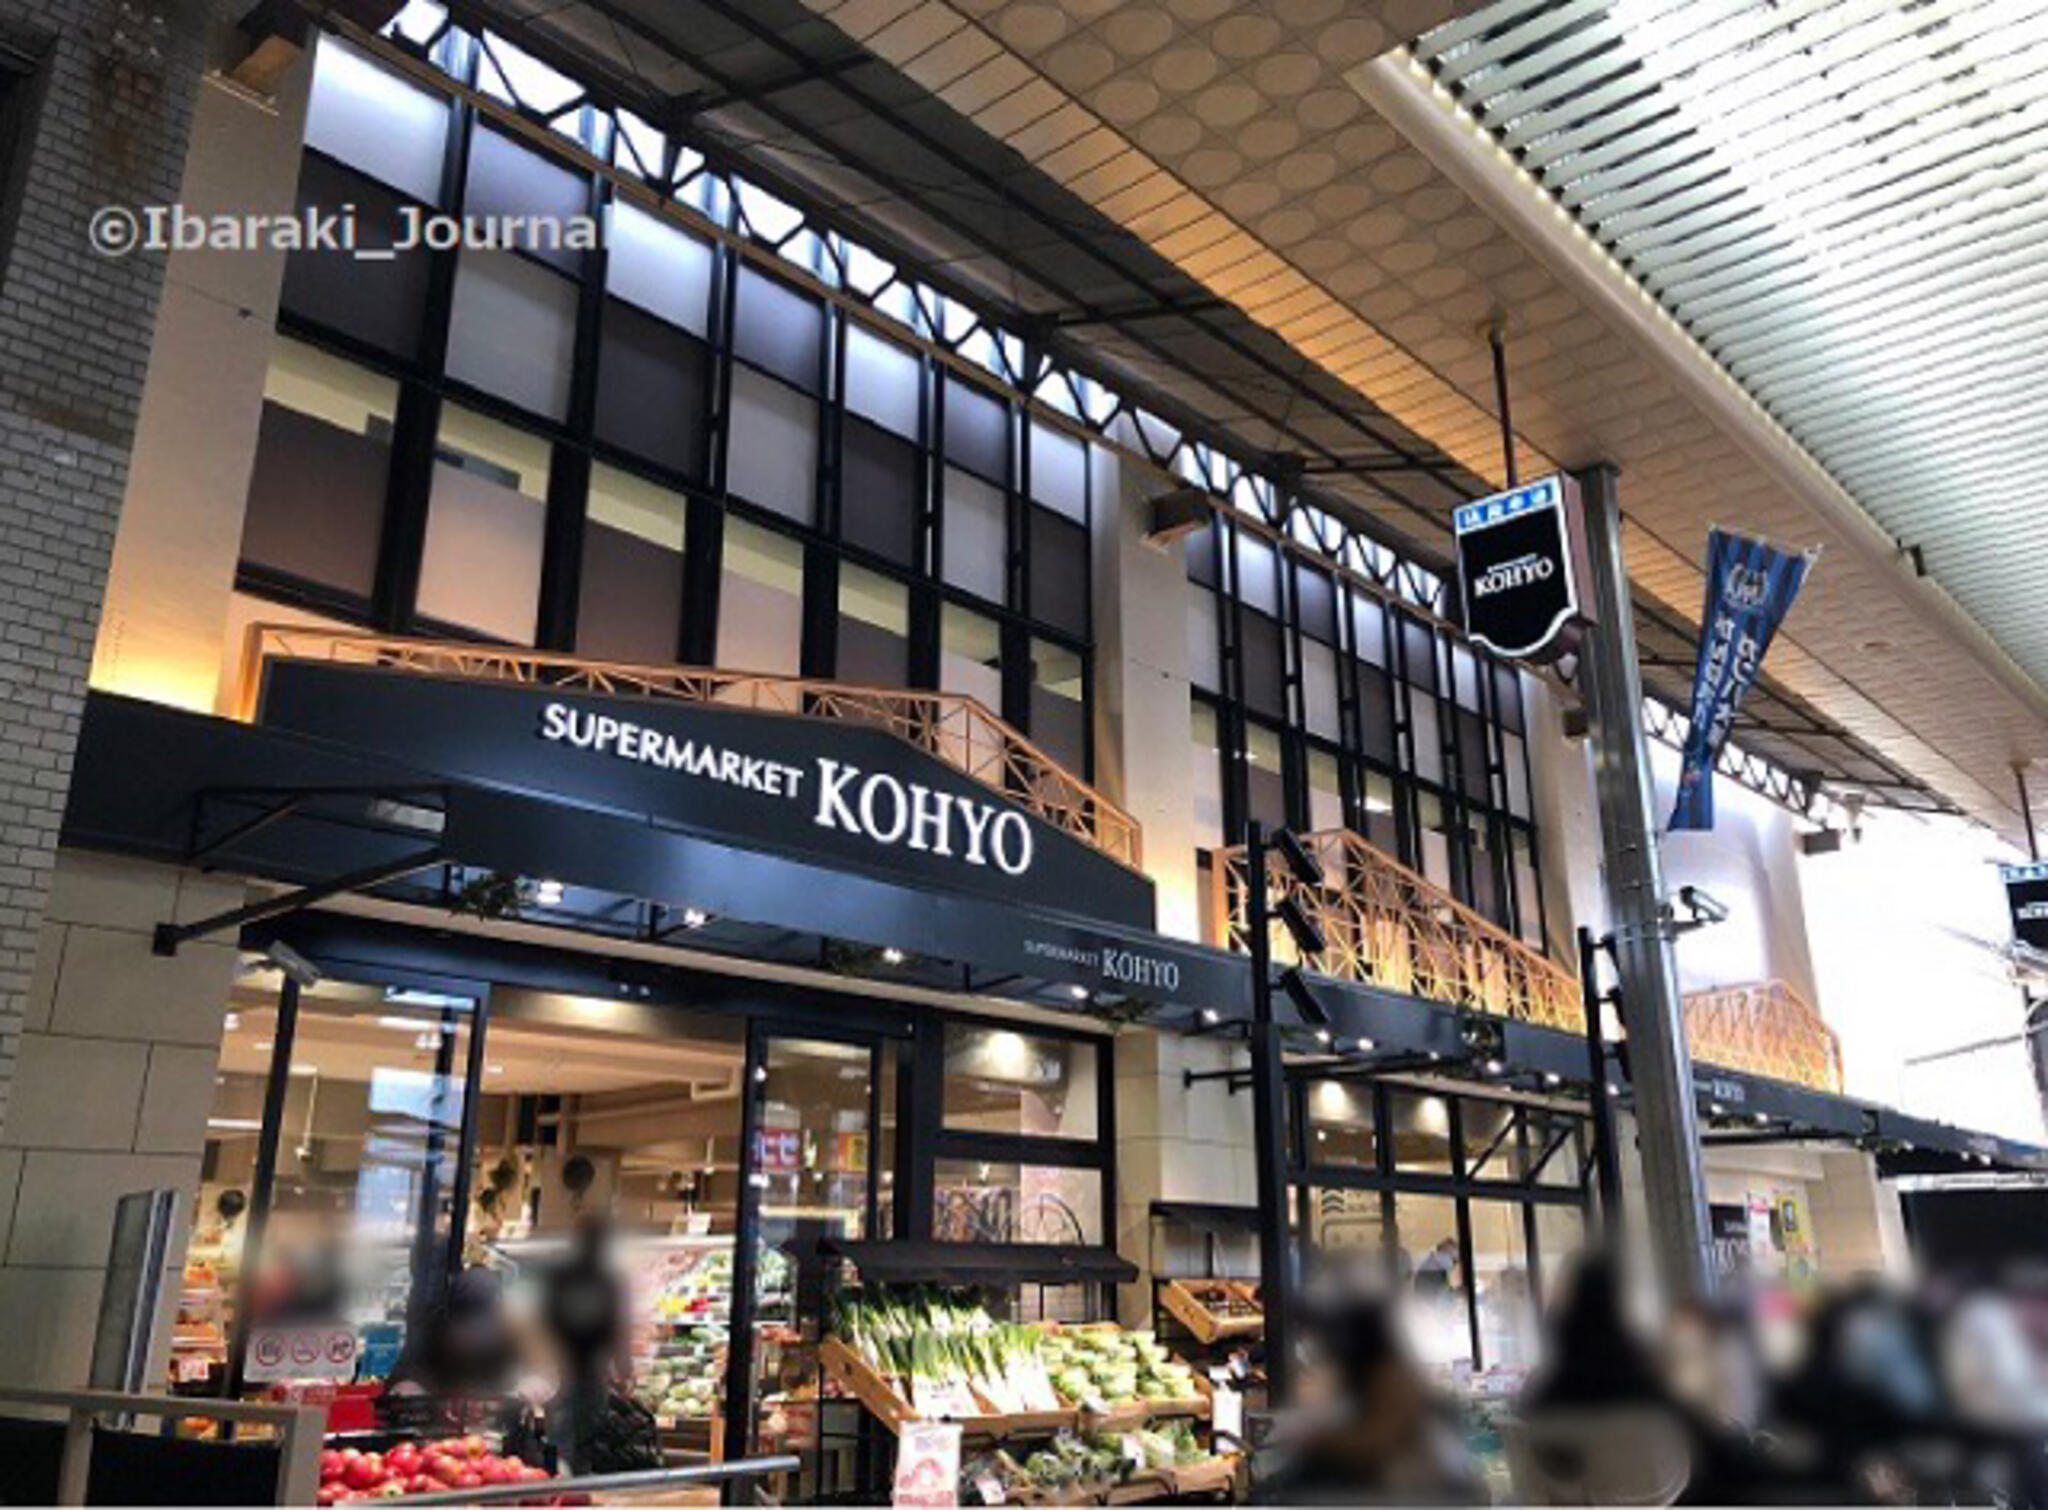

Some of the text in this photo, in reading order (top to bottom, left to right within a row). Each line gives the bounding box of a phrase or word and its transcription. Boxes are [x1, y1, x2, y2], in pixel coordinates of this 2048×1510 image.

[1474, 556, 1554, 599] KOHYO
[543, 703, 1033, 876] SUPERMARKET KOHYO
[1102, 947, 1180, 992] KOHYO
